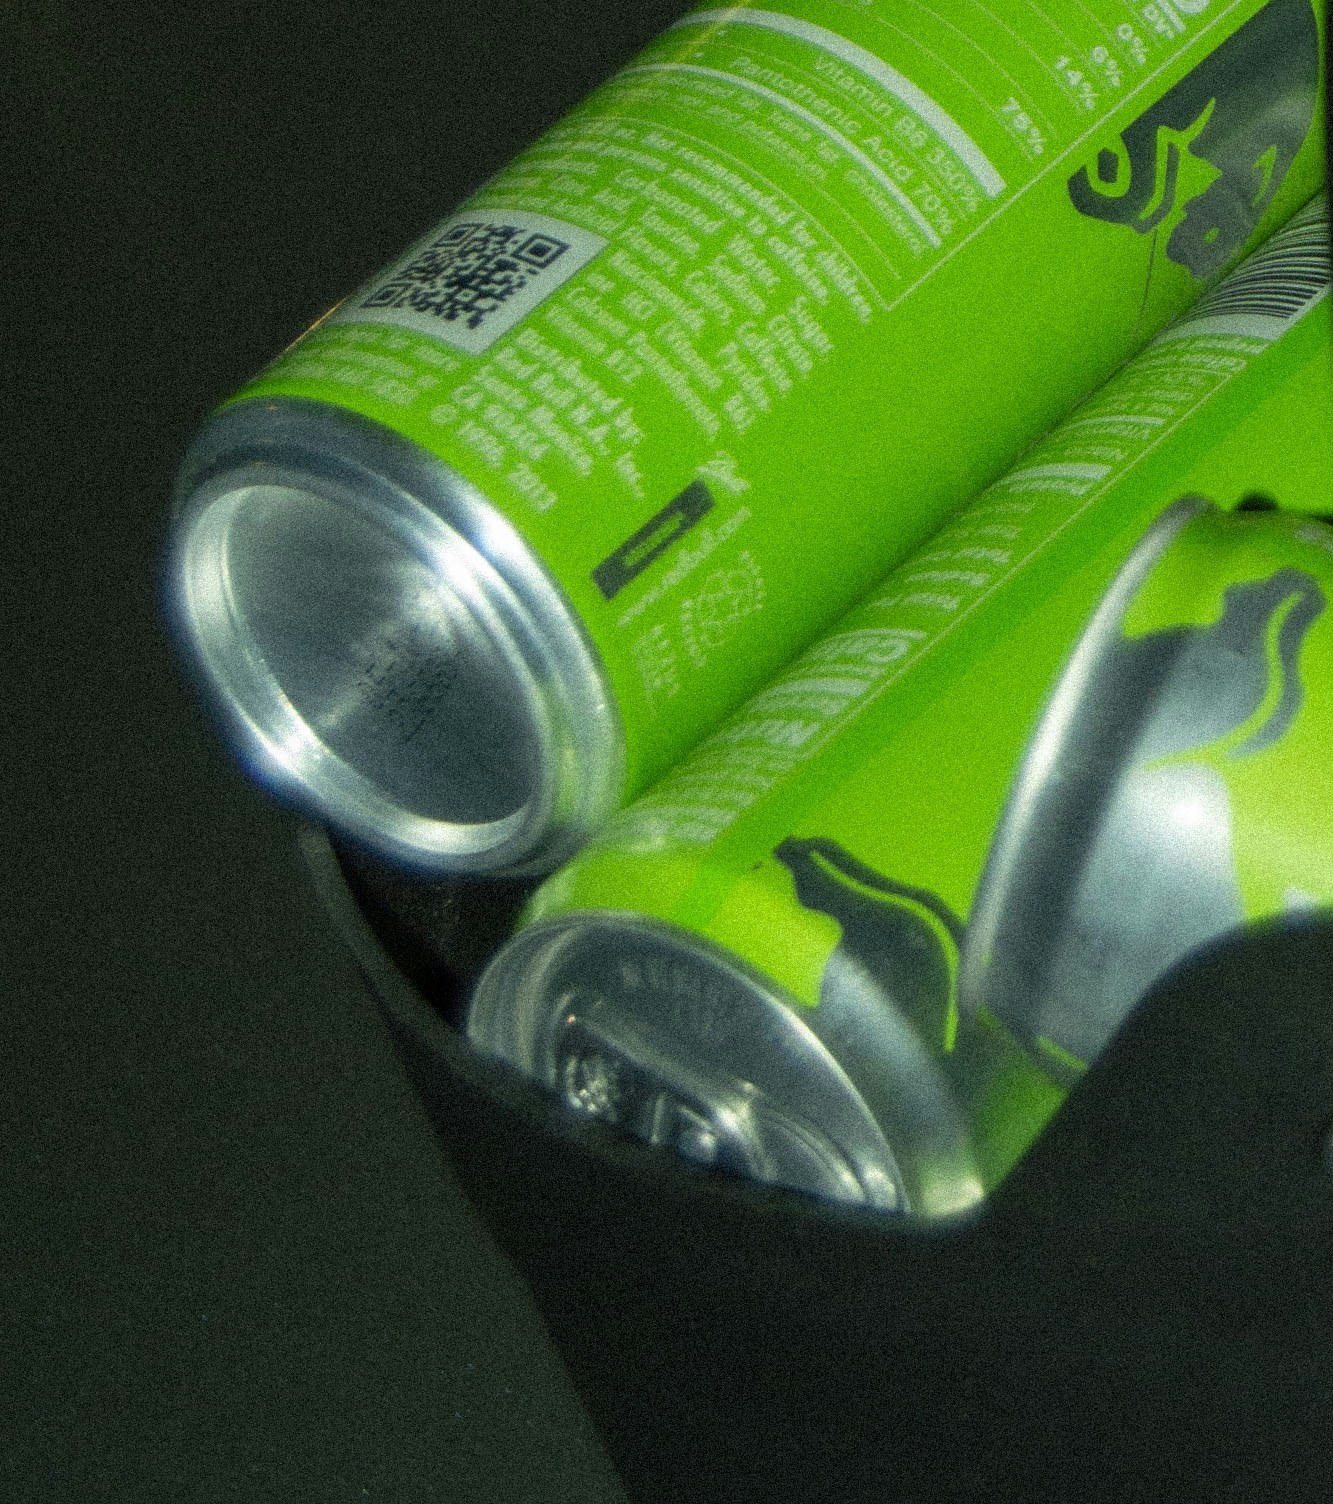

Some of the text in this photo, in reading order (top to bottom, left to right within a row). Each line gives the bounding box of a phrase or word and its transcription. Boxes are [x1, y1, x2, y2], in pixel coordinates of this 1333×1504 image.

[1088, 44, 1129, 88] 6%
[1113, 22, 1154, 66] 0%
[1051, 56, 1103, 111] 14%
[729, 50, 864, 135] Pantothenic
[861, 129, 918, 184] Acid
[912, 182, 960, 236] 70%
[812, 55, 987, 214] Vitamin B6 350%
[1001, 100, 1051, 154] 75%
[612, 163, 724, 238] Carbonated
[668, 162, 750, 220] sensitive
[744, 212, 772, 238] to
[672, 143, 793, 227] recommended
[705, 254, 774, 317] Sodium
[491, 344, 538, 383] Red
[529, 369, 579, 412] Bull
[513, 327, 622, 417] Distributed
[542, 302, 645, 386] Vitamin B12
[449, 382, 552, 463] CA 90404
[472, 363, 532, 411] Santa
